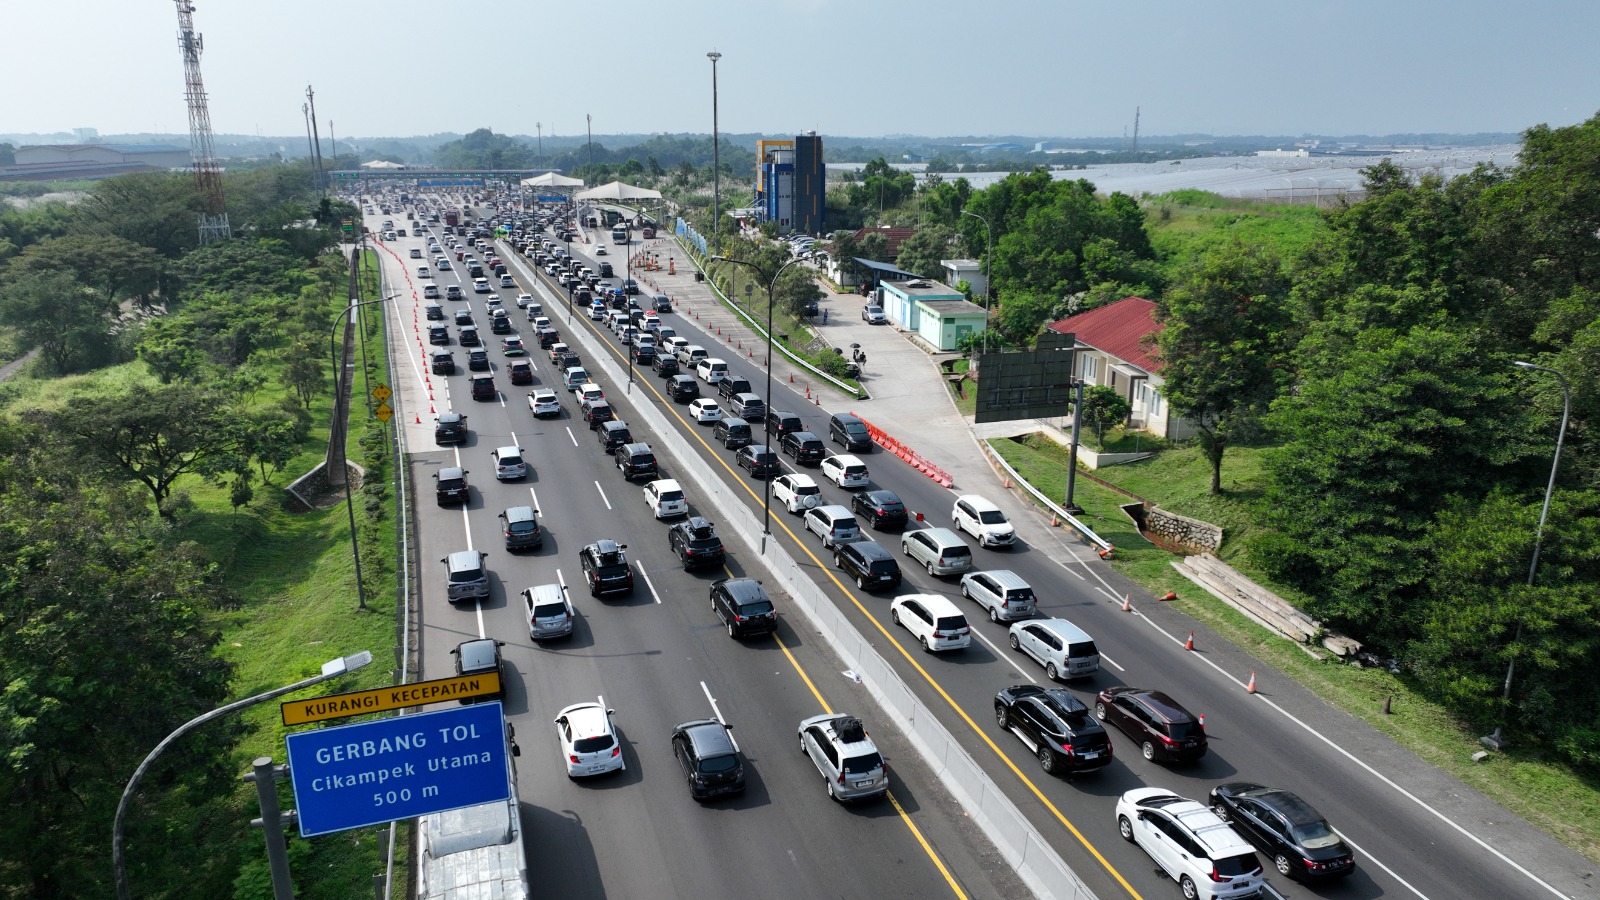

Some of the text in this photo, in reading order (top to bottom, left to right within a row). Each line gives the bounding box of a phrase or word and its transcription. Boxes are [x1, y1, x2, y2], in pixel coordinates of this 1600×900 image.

[305, 679, 480, 717] KURANGI KECEPATAN
[316, 723, 480, 764] GERBANG TOL
[312, 751, 491, 792] Cikampek Utama
[374, 785, 439, 806] 500 m
